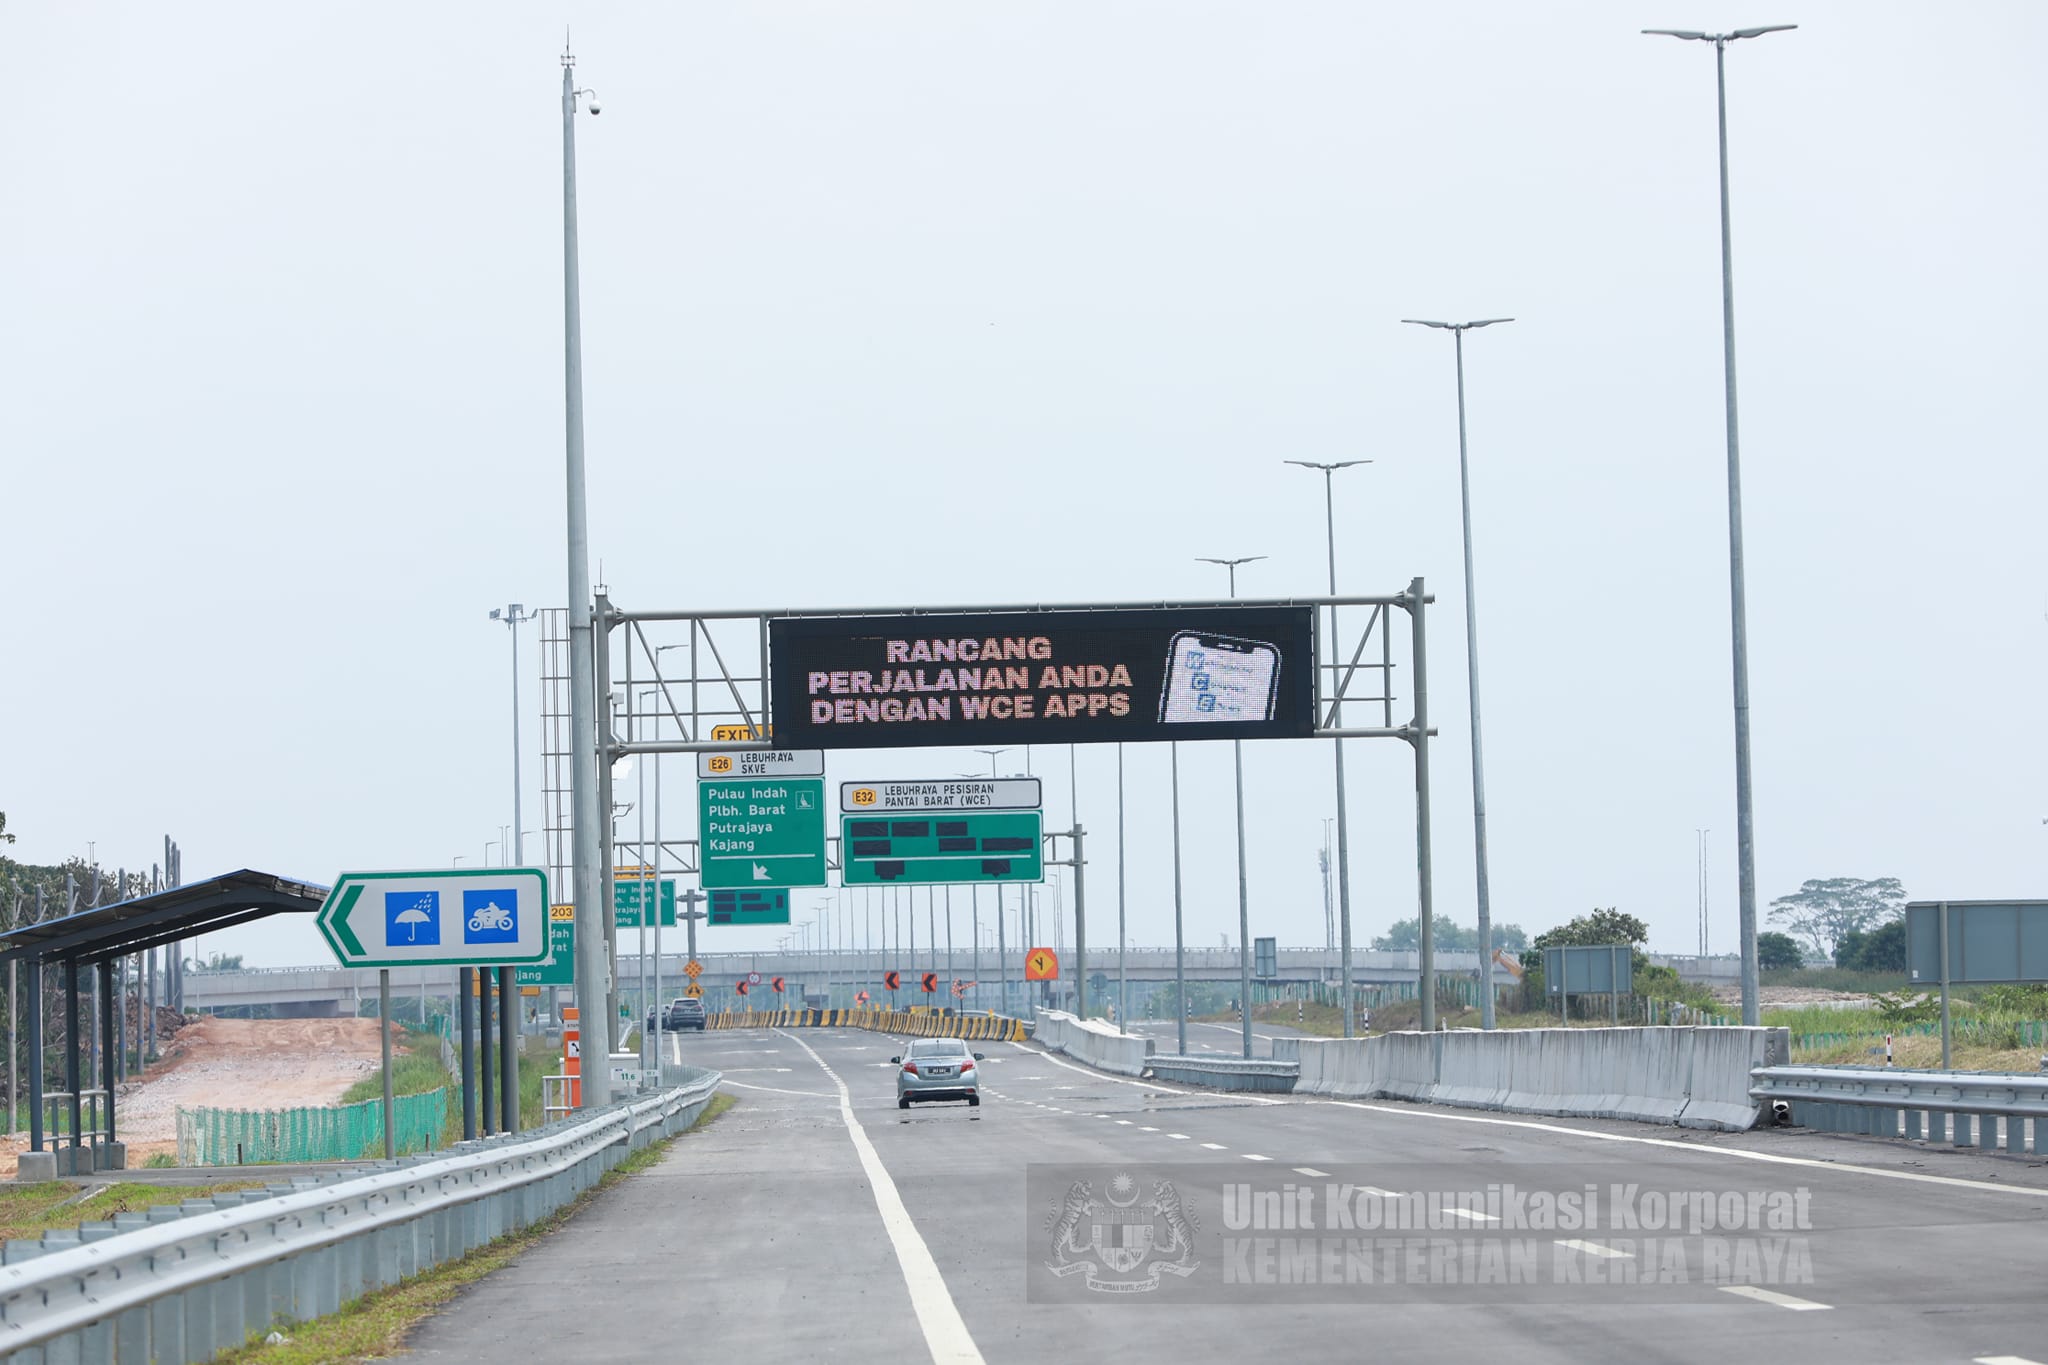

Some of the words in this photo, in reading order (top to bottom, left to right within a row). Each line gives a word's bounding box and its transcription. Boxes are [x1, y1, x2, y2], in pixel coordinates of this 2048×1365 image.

[887, 637, 1052, 663] RANCANG
[808, 666, 1029, 694] PERJALANAN
[1038, 664, 1133, 689] ANDA
[811, 695, 951, 724] DENGAN
[959, 695, 1035, 720] WCE
[1043, 692, 1131, 718] APPS
[740, 752, 794, 763] LEBUHRAYA
[711, 759, 729, 770] E26
[741, 763, 766, 774] SKVE
[708, 788, 745, 799] Pulau
[751, 787, 787, 799] Indah
[884, 785, 938, 796] LEBUHRAYA
[943, 784, 994, 795] PESISIRAN
[855, 792, 874, 802] E32
[885, 797, 919, 807] PANTAI
[924, 796, 954, 806] BARAT
[960, 794, 992, 806] (WCE)
[709, 805, 743, 816] Plbh.
[749, 804, 786, 816] Barat
[709, 822, 773, 835] Putrajaya
[709, 839, 755, 851] Kajang
